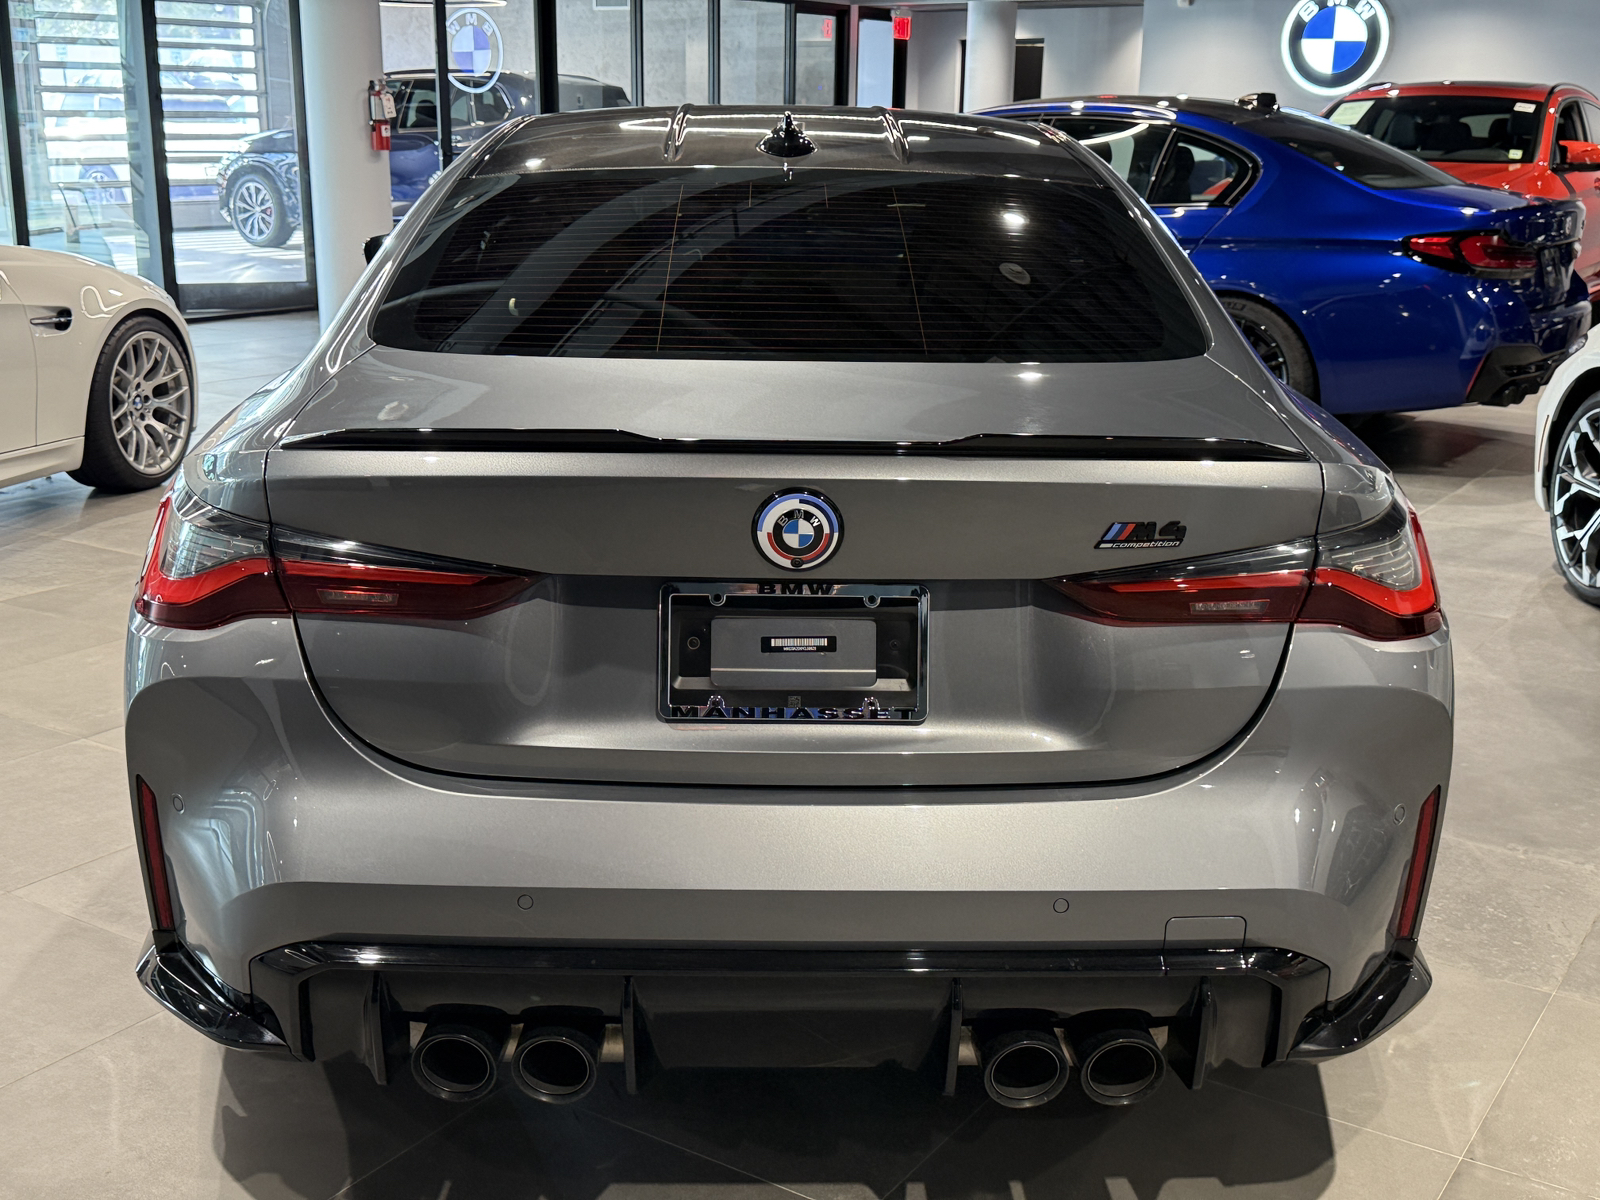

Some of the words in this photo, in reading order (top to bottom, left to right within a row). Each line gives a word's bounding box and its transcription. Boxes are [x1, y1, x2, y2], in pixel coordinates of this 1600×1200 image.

[1298, 0, 1376, 22] BMW
[777, 510, 821, 527] BMW
[1128, 520, 1187, 540] M4
[1112, 541, 1180, 549] competition
[757, 583, 834, 595] BMW
[672, 706, 917, 720] MANHASSET
